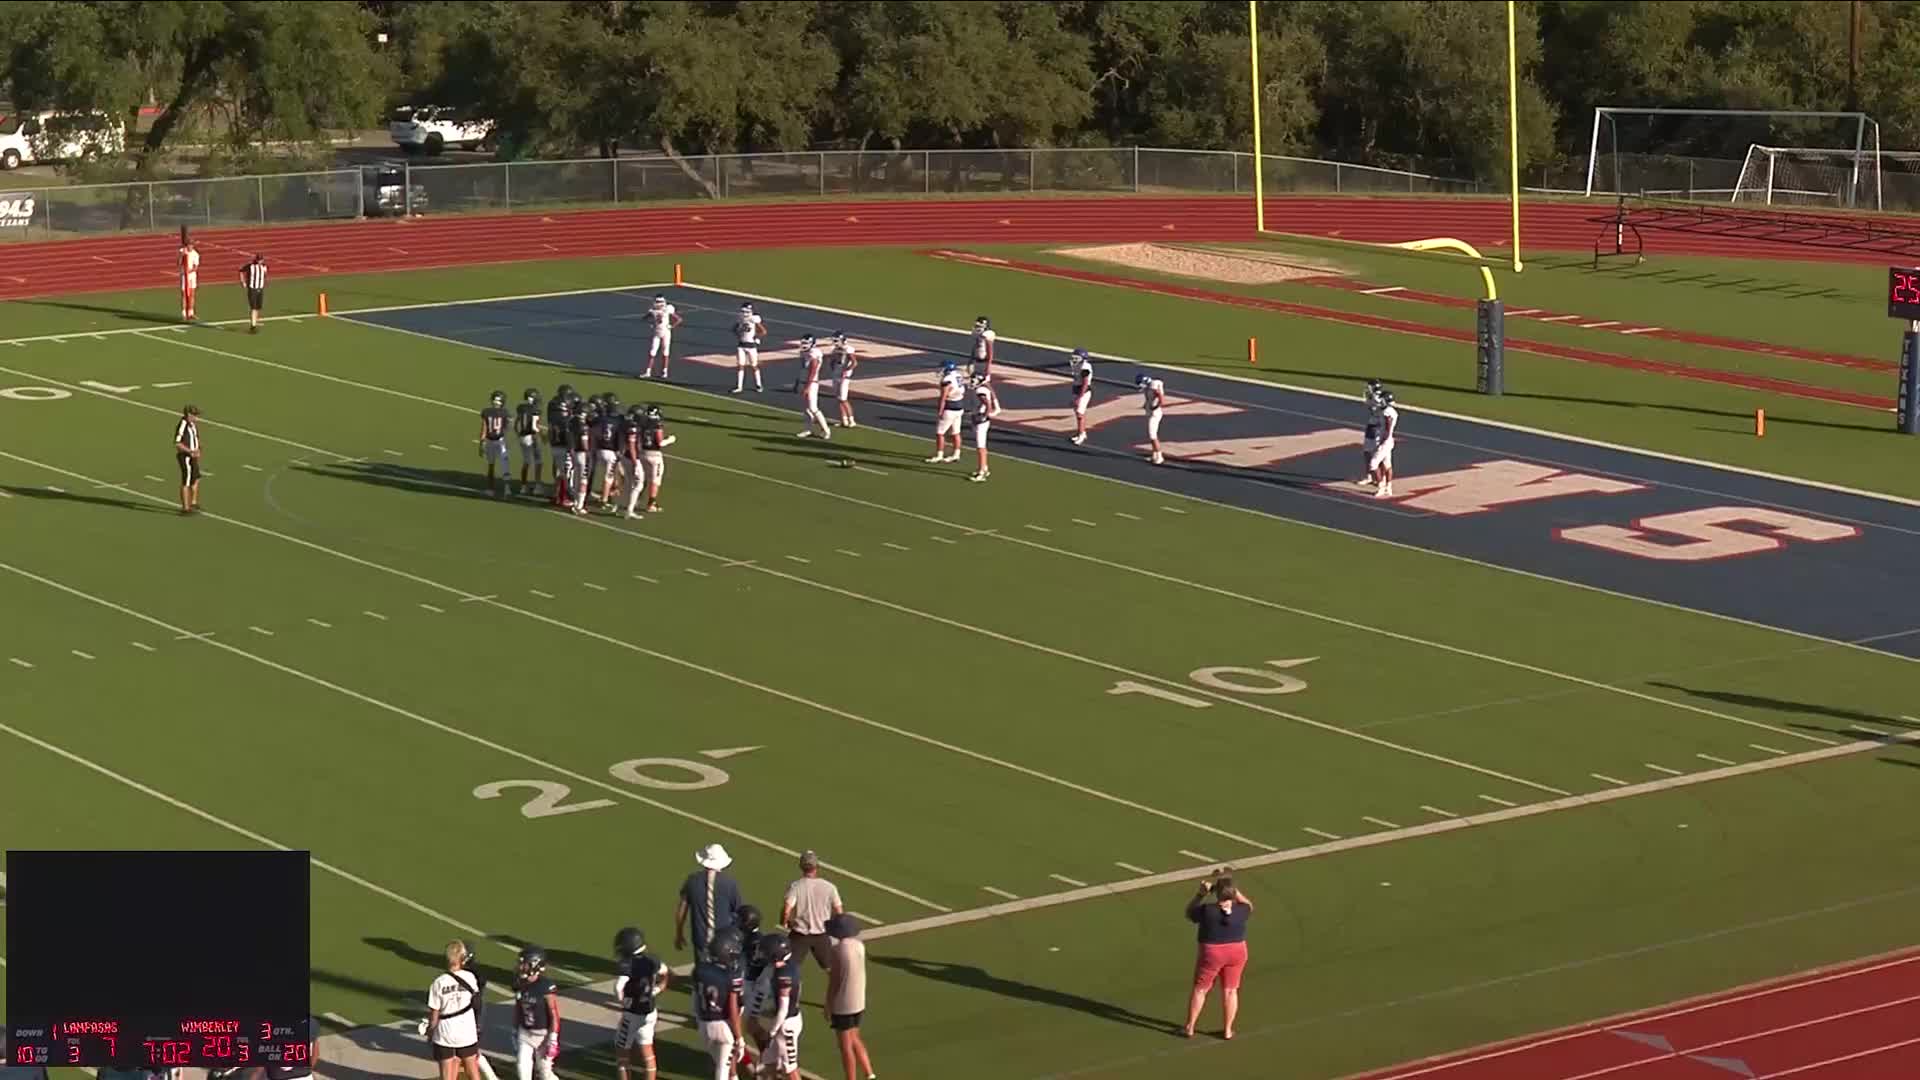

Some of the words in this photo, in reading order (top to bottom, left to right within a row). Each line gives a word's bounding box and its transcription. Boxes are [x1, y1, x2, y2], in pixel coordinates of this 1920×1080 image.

[1892, 272, 1920, 304] 25
[681, 333, 1863, 562] TEXANS
[1105, 666, 1308, 709] 10
[472, 757, 730, 818] 20
